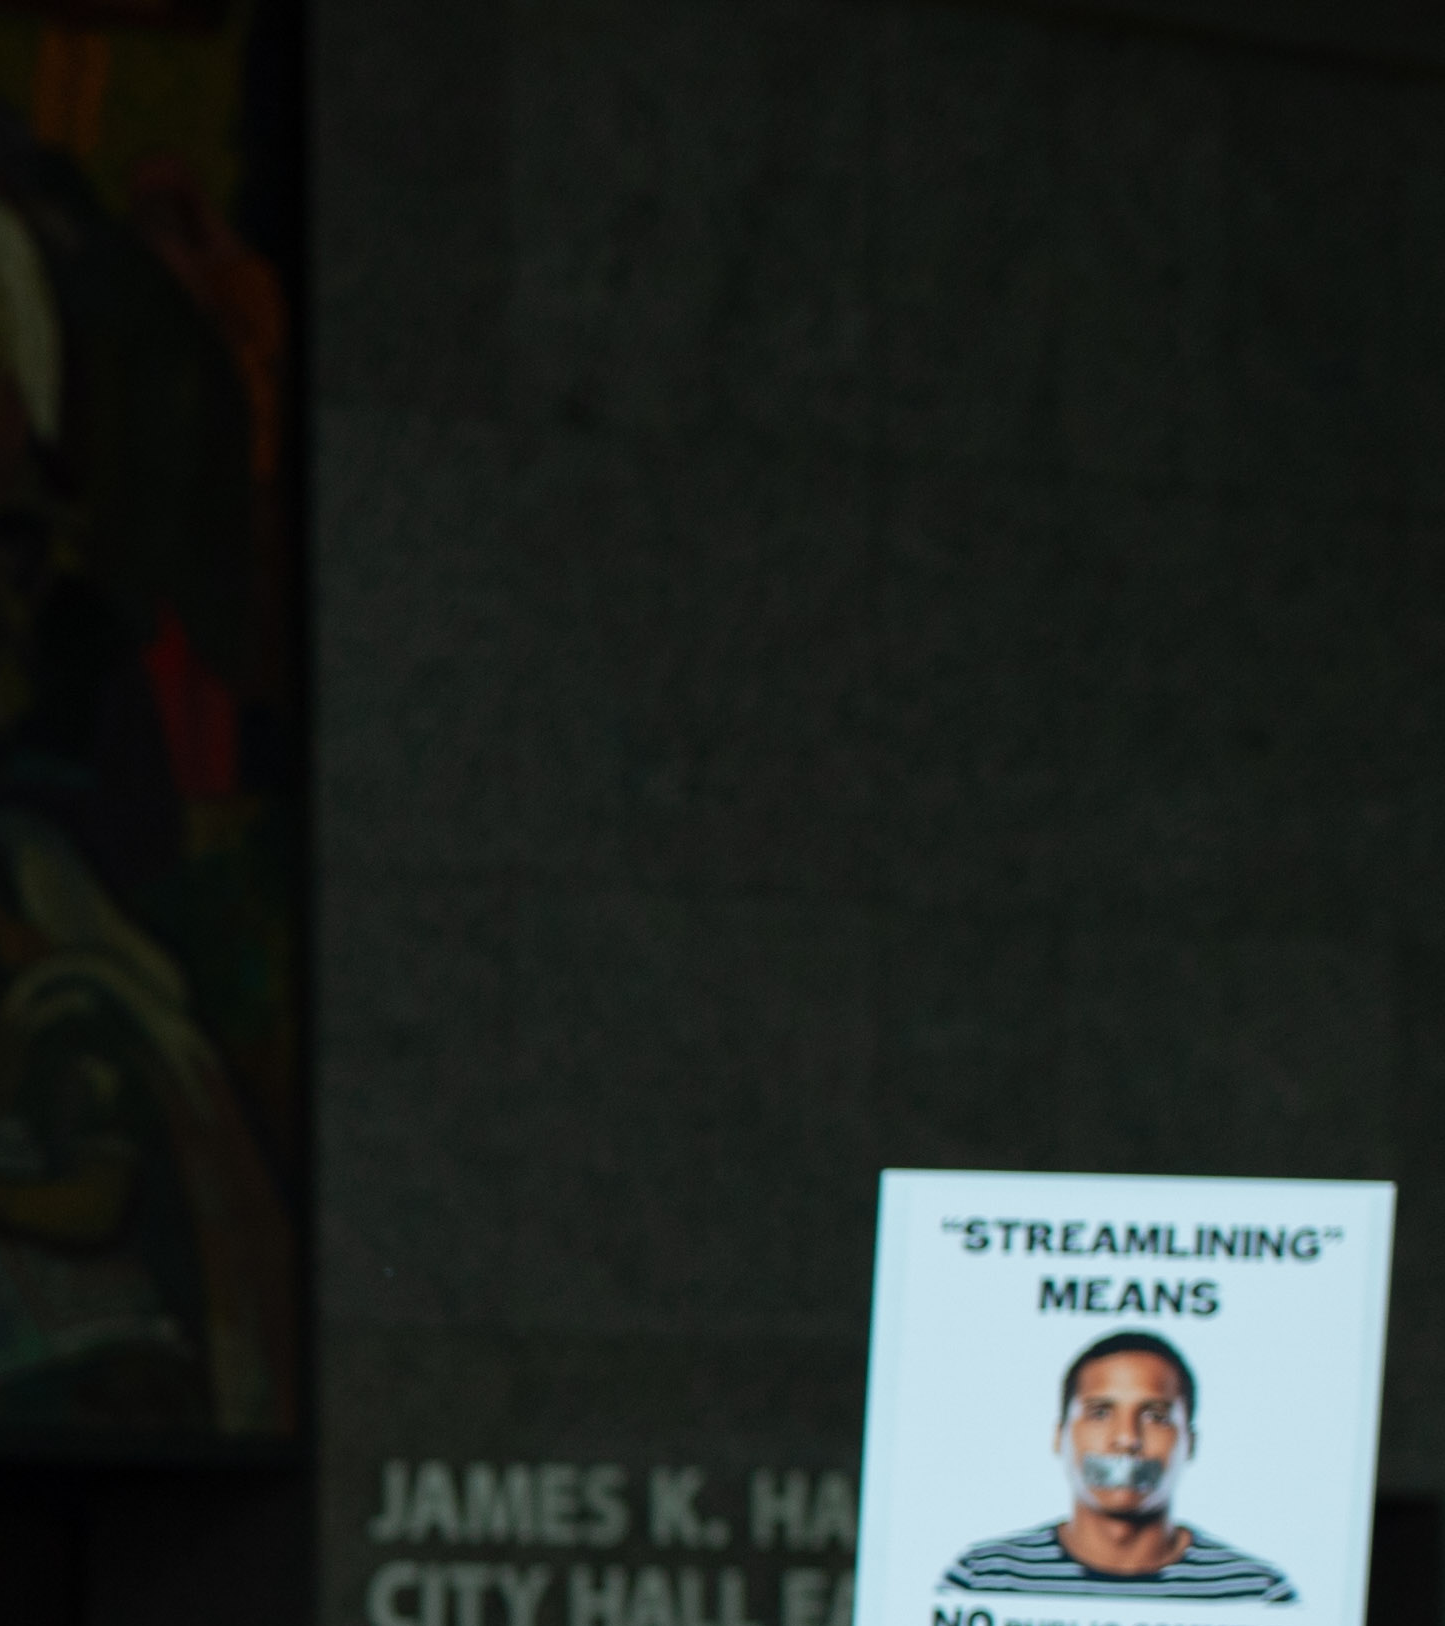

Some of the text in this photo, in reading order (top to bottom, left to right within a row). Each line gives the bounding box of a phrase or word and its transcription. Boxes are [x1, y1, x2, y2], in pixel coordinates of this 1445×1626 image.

[1038, 1278, 1221, 1317] MEANS
[368, 1459, 632, 1546] JAMES
[647, 1465, 731, 1551] K.
